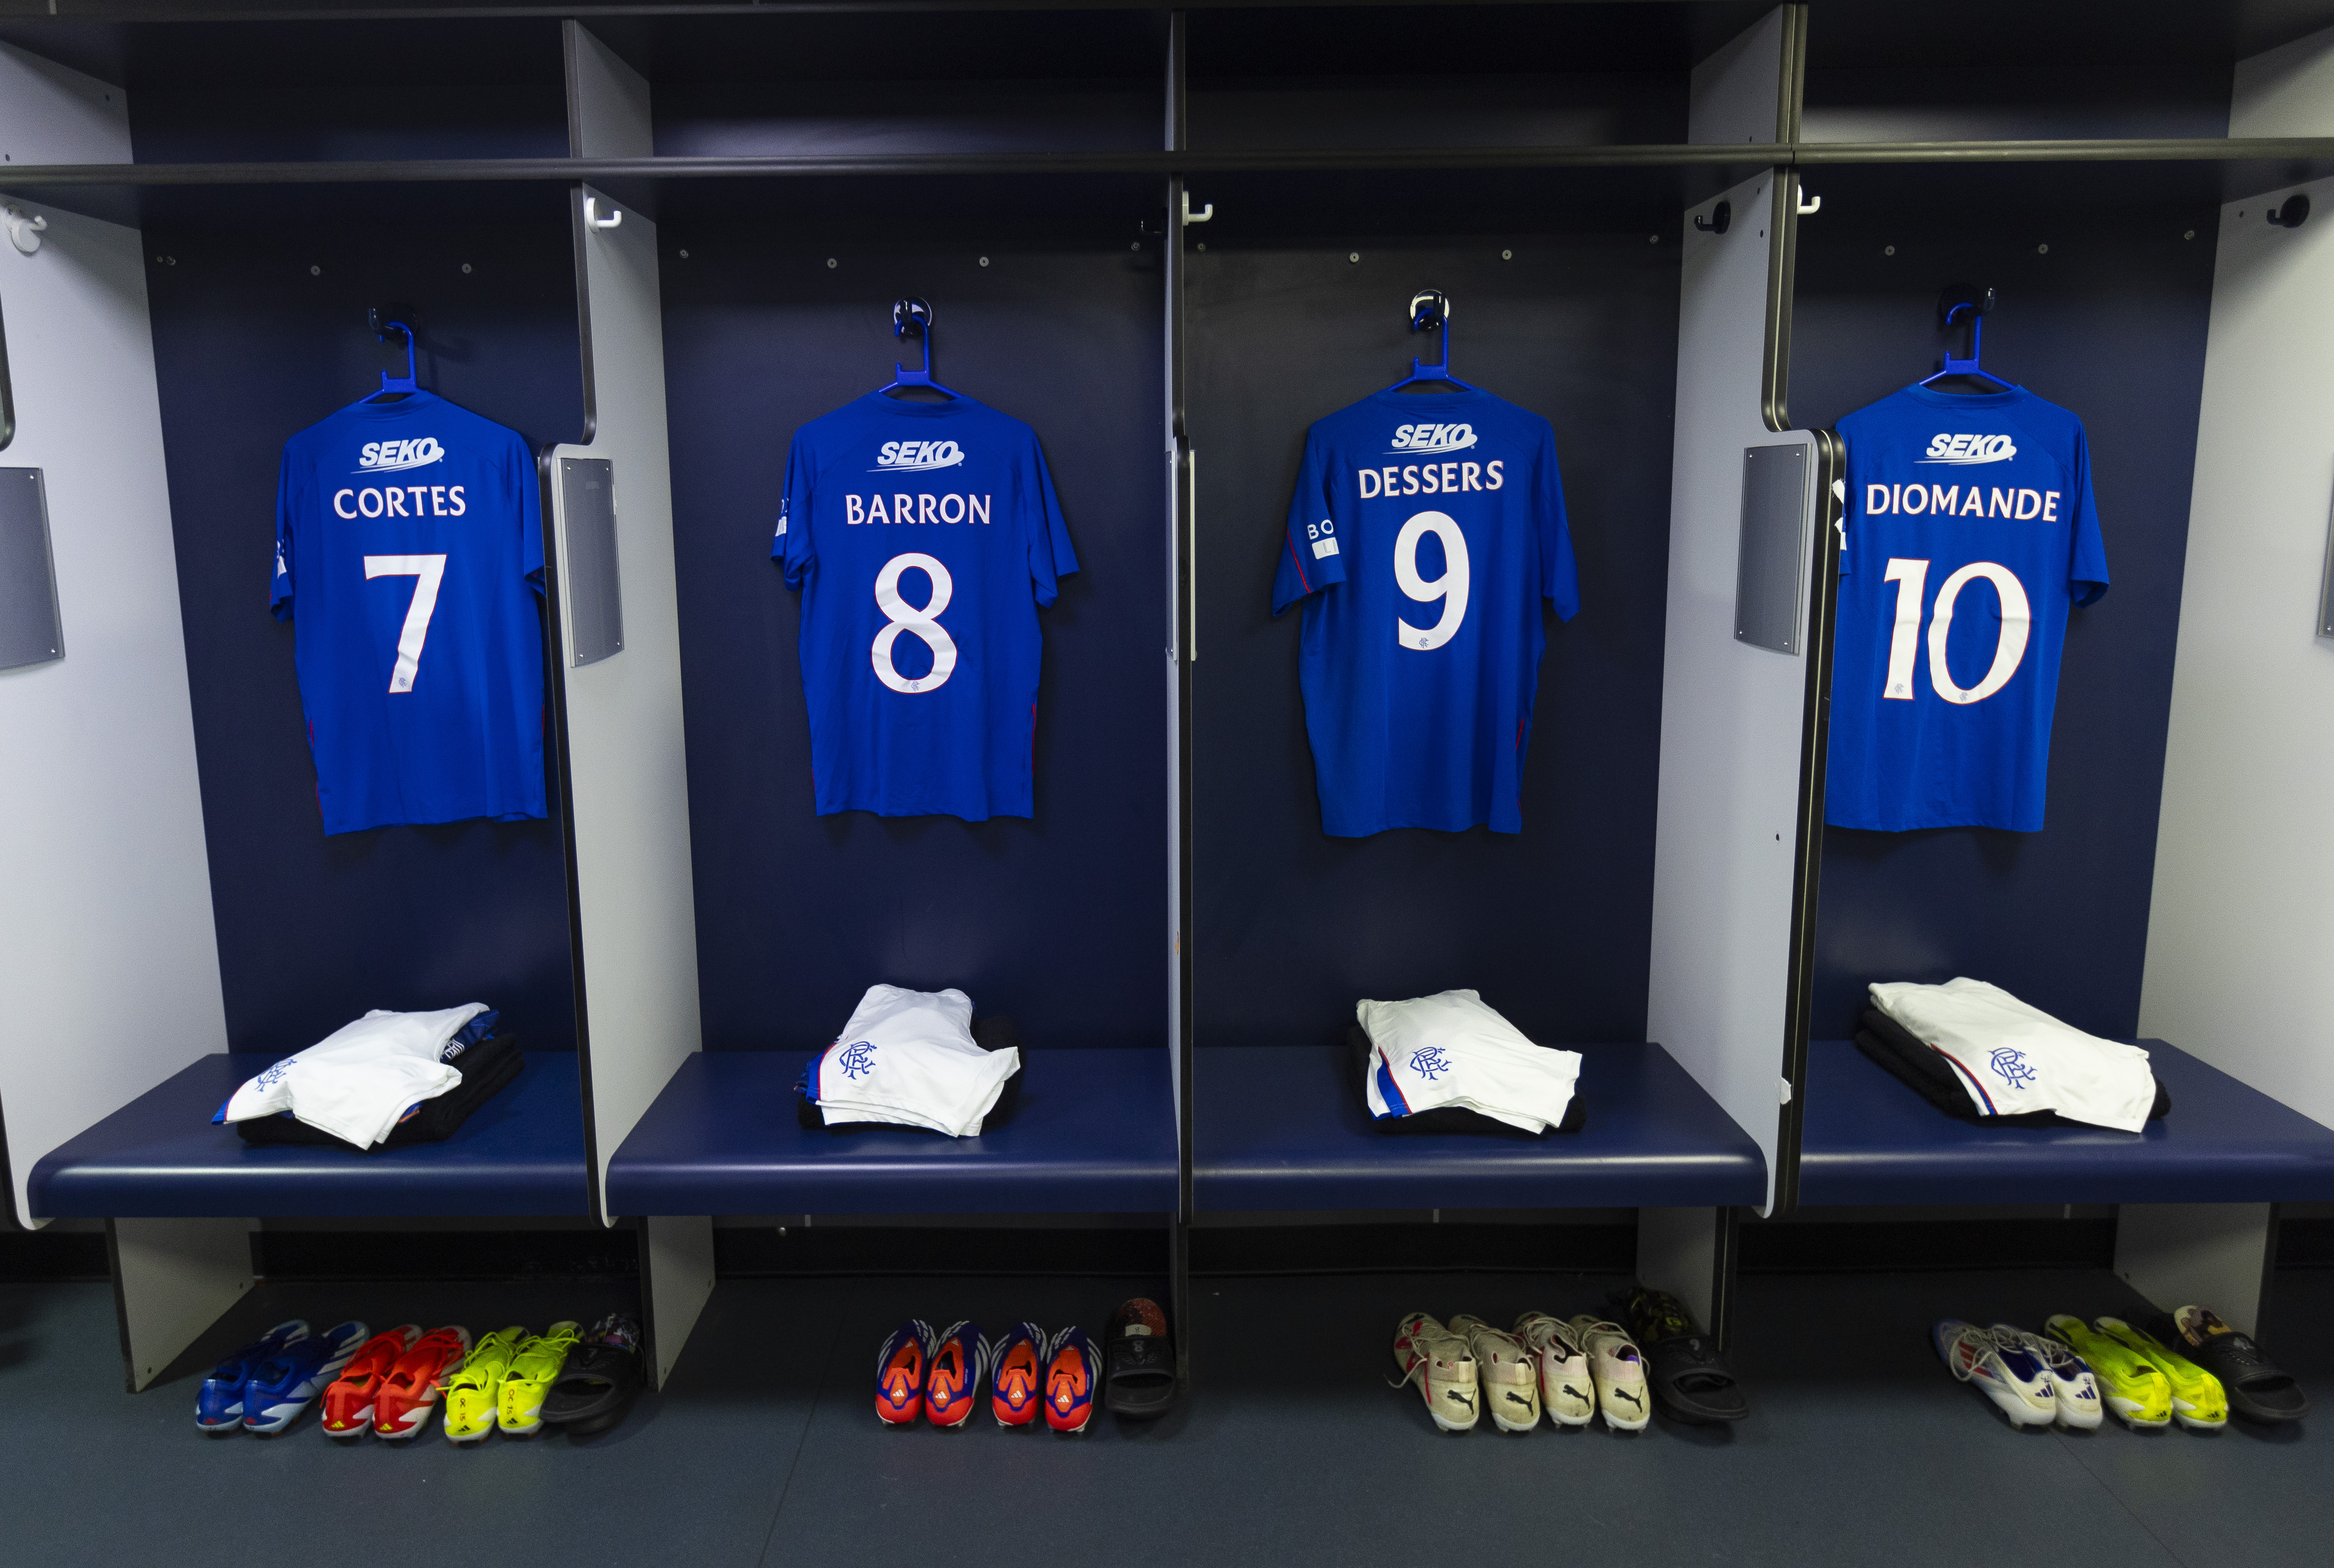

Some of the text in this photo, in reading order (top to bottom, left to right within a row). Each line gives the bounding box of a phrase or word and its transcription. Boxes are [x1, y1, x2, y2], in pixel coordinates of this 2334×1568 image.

[359, 437, 445, 467] SEKO
[877, 441, 965, 466] SEKO
[1391, 423, 1477, 449] SEKO
[1926, 433, 2017, 460] SEKO
[1358, 460, 1504, 499] DESSERS
[333, 486, 466, 519] CORTES
[845, 493, 991, 525] BARRON
[1866, 483, 2061, 523] DIOMANDE
[1394, 510, 1470, 651] 9
[363, 554, 447, 694] 7
[871, 552, 958, 694] 8
[1883, 557, 2031, 705] 10
